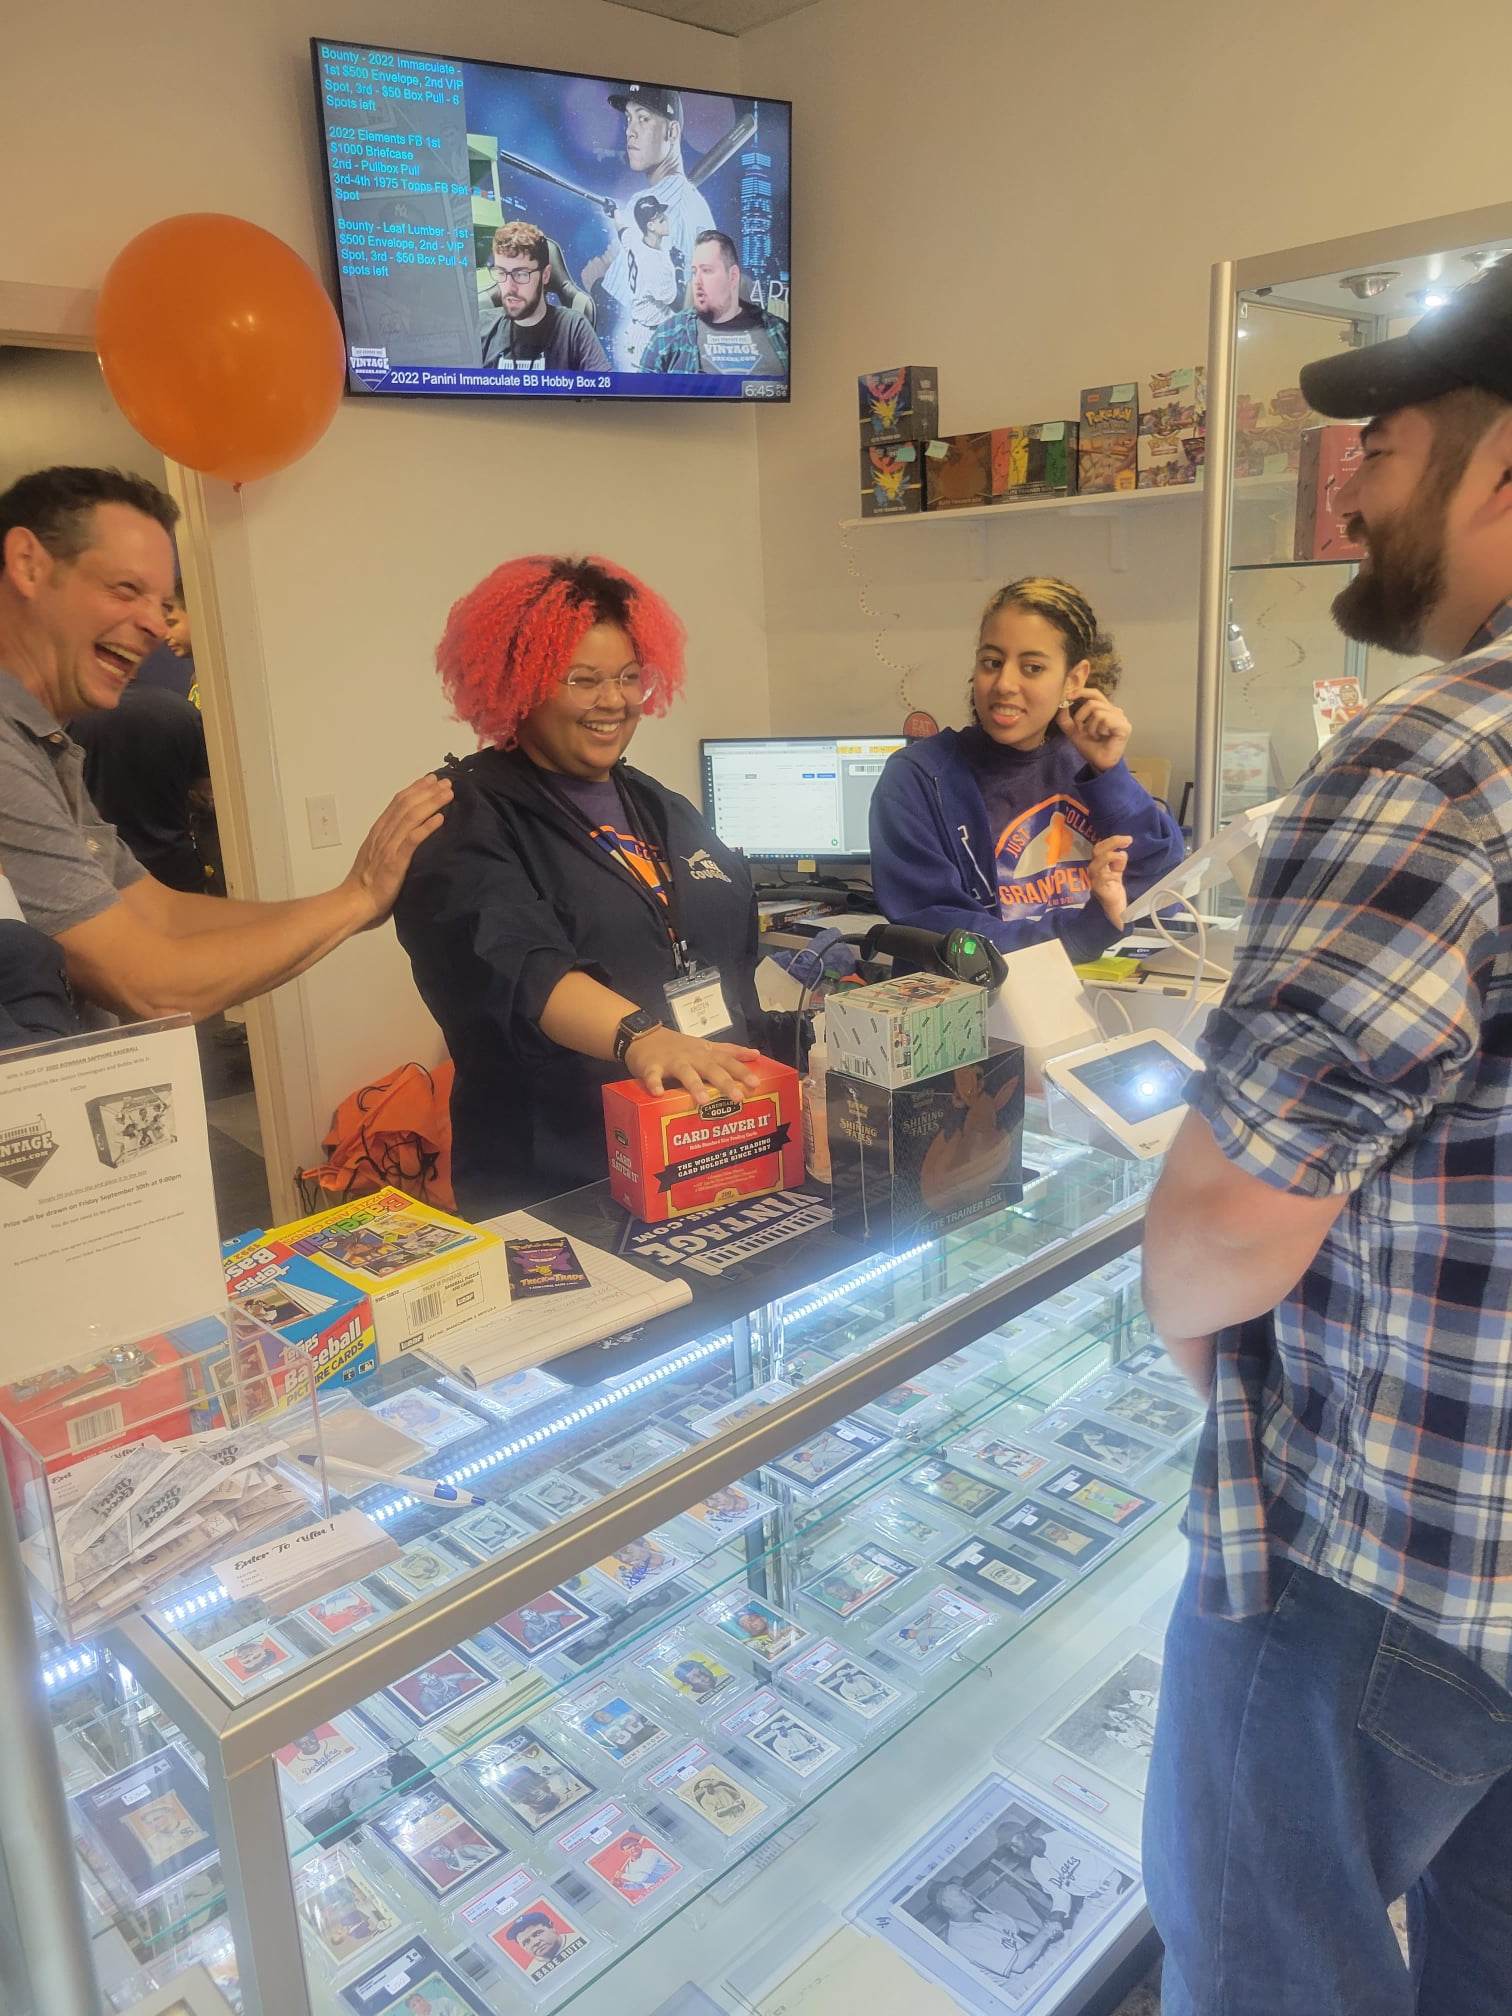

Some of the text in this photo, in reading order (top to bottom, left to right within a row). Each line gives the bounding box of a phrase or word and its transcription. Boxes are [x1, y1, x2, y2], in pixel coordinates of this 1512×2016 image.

[322, 47, 455, 74] Bounty 2022 Immaculate
[324, 64, 464, 90] 1st $500 Envelope, 2nd VIP
[326, 95, 376, 111] Spots left
[355, 83, 372, 95] 3rd
[382, 85, 400, 98] $50
[403, 89, 423, 101] Box
[426, 92, 444, 104] Pull
[329, 127, 441, 149] 2022 Elements FB 1st
[330, 142, 414, 160] $1000 Briefcase
[332, 158, 420, 176] 2nd Pullbox Pull
[334, 173, 370, 187] 3rd-4th
[374, 177, 398, 189] 1975
[400, 179, 432, 193] Topps
[434, 182, 448, 193] FB
[335, 188, 360, 200] Spot
[337, 218, 374, 233] Bounty
[383, 222, 405, 233] Leaf
[408, 224, 444, 237] Lumber
[339, 234, 365, 246] $500
[419, 240, 438, 250] 2nd
[447, 241, 464, 251] VIP
[370, 250, 388, 261] 3rd
[396, 252, 414, 263] $50
[417, 253, 436, 265] Box
[438, 255, 456, 266] Pull
[342, 266, 389, 277] spots left
[350, 356, 390, 370] VINTAGE
[391, 371, 611, 390] 2022 Panini Immaculate BB Hobby Box 28
[744, 385, 775, 397] 6:45
[1006, 827, 1031, 859] JUST
[711, 1106, 732, 1117] GOLD
[673, 1128, 710, 1146] CARD
[712, 1118, 755, 1138] SAVER
[840, 1118, 878, 1137] SHINING
[0, 1131, 52, 1158] NTAGE
[677, 1163, 693, 1171] THE
[694, 1152, 727, 1166] WORLD'S
[740, 1138, 771, 1151] TRADING
[677, 1167, 698, 1178] CARD
[700, 1158, 729, 1171] HOLDER
[730, 1151, 752, 1161] SINCE
[78, 1198, 99, 1208] Friday
[100, 1188, 134, 1201] September
[946, 1201, 984, 1223] TRAINER
[290, 1193, 413, 1257] Baseball
[632, 1190, 824, 1266] VINTAGE
[331, 1339, 365, 1371] CARDS
[233, 1551, 270, 1571] Enter
[271, 1542, 291, 1553] To
[535, 1939, 584, 1979] BABE RUTH
